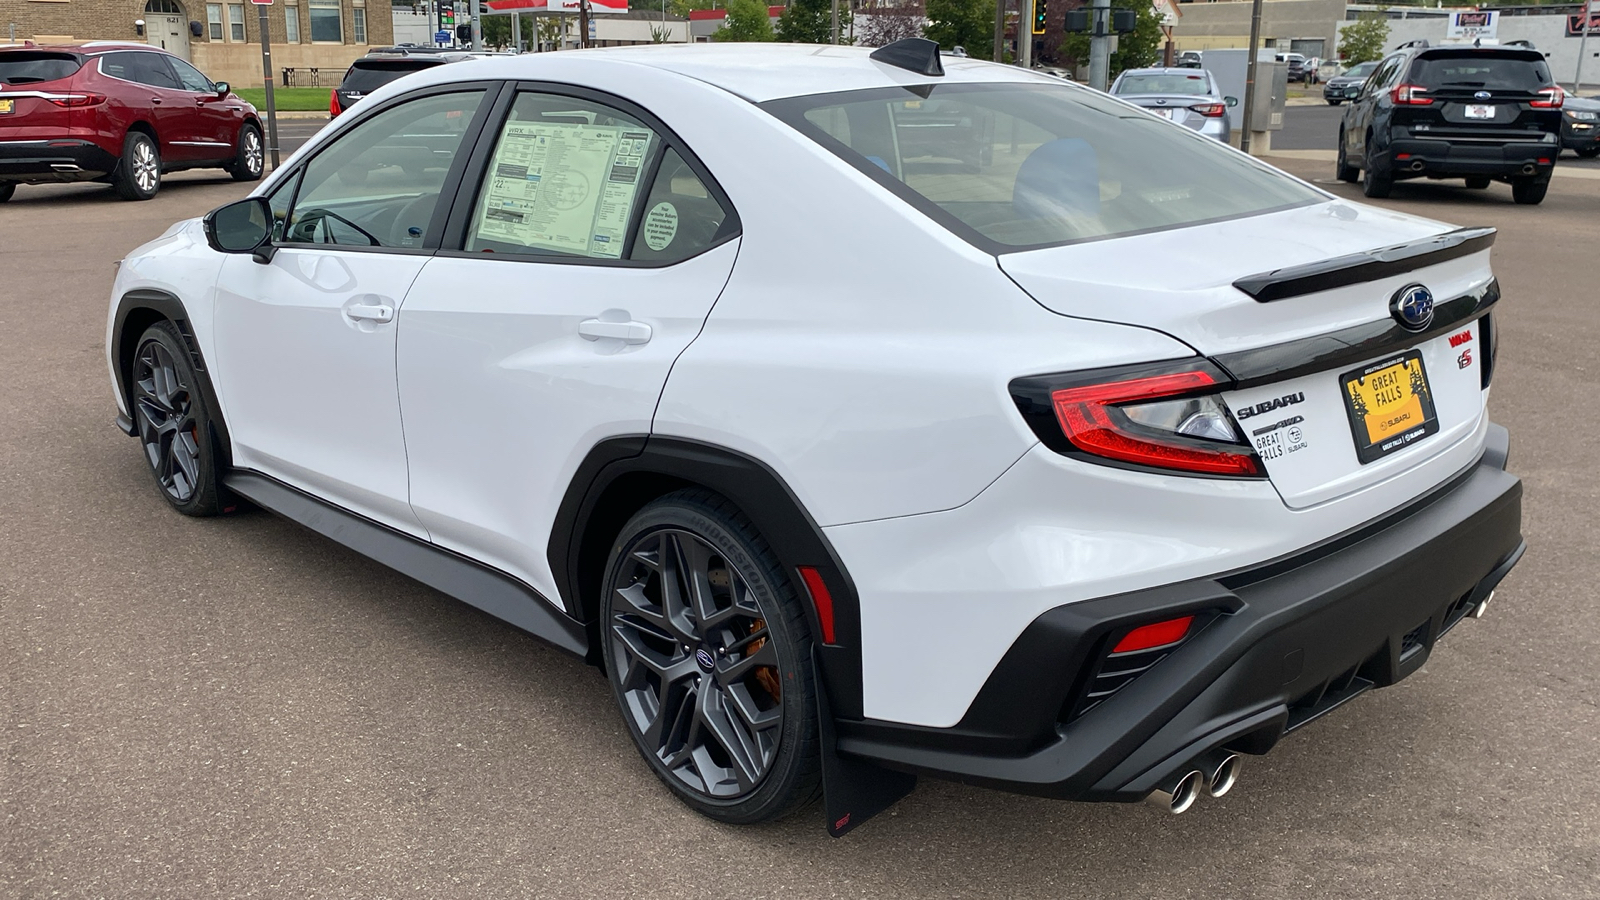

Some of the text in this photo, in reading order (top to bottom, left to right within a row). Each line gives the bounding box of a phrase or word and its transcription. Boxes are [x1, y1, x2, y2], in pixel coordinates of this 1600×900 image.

[1448, 330, 1473, 348] WRX
[1372, 371, 1398, 391] GREAT
[1375, 386, 1402, 407] FALLS
[1237, 391, 1305, 420] SUBARU
[1388, 412, 1411, 427] SUBARU
[1256, 432, 1280, 449] GREAT
[1288, 441, 1308, 453] SUBARU
[1259, 445, 1283, 461] FALLS
